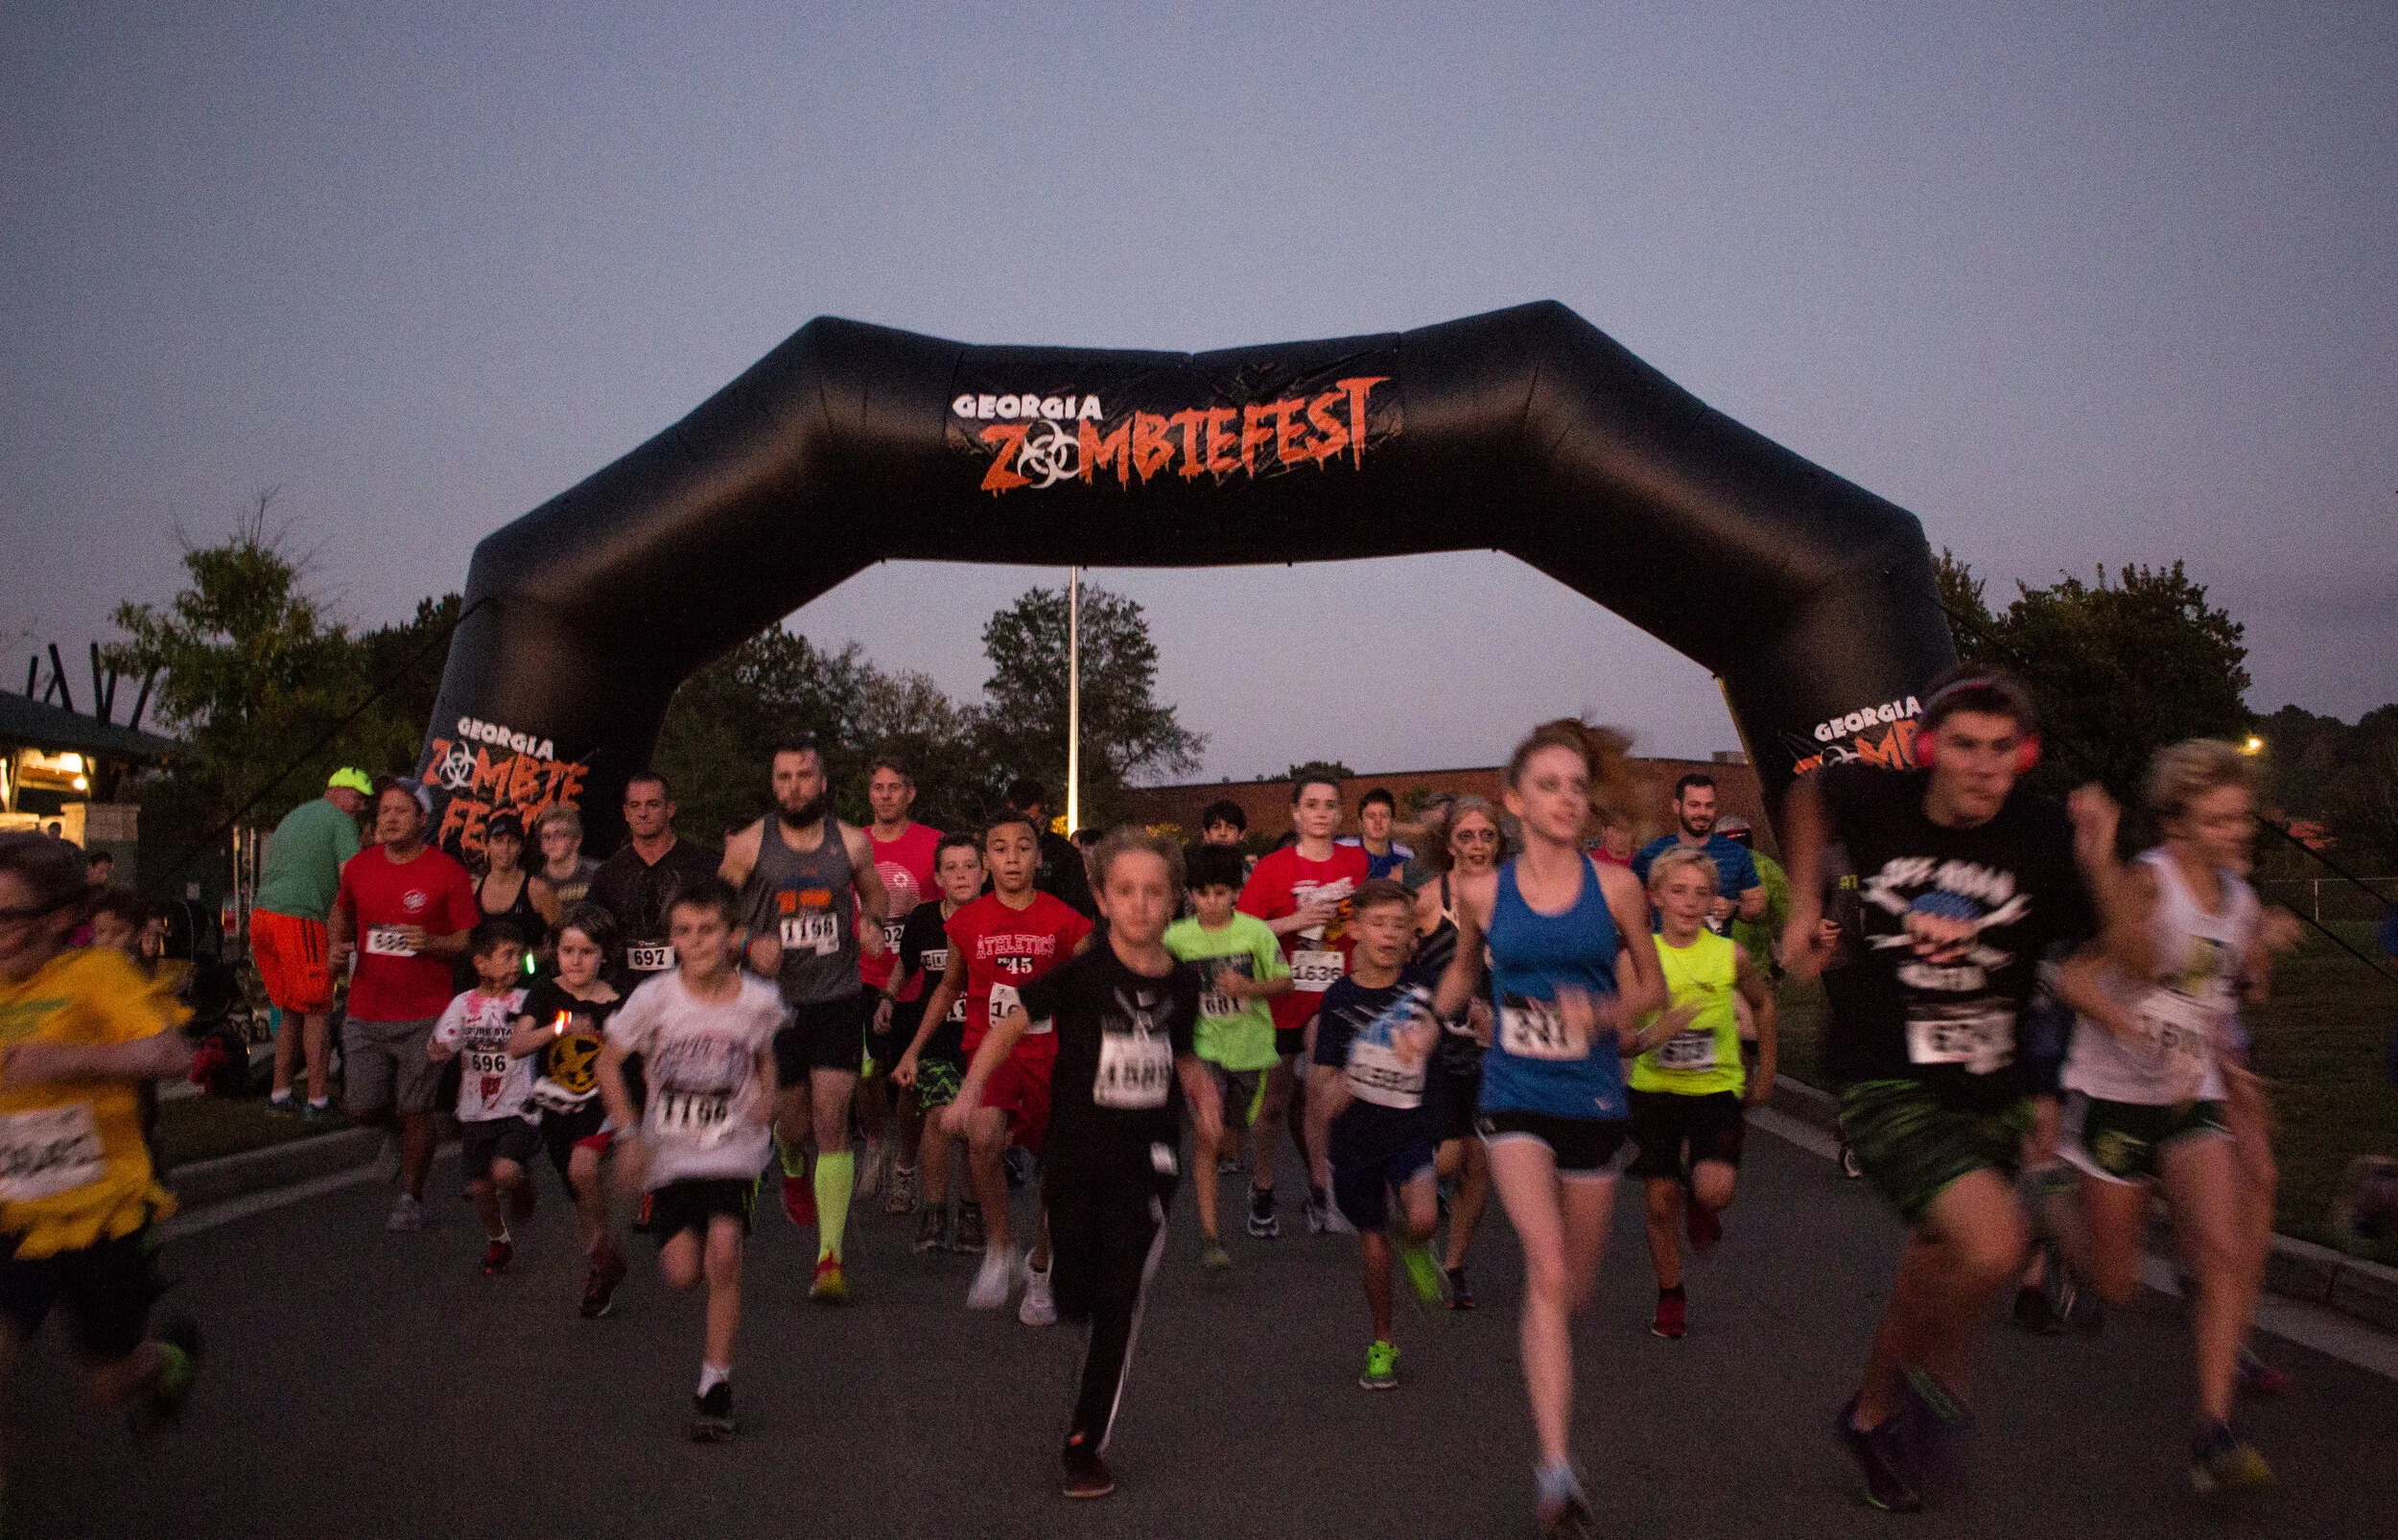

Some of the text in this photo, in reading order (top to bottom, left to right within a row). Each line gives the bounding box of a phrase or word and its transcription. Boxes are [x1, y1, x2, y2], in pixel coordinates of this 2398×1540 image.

[952, 394, 1103, 421] GEORGIA
[979, 376, 1390, 498] ZOMBIEFEST
[1814, 696, 1923, 743] GEORGIA
[457, 716, 554, 761] GEORGIA
[438, 797, 541, 856] FET
[634, 949, 665, 966] 697
[976, 934, 1055, 959] ATHLETICS
[1005, 957, 1033, 974] 45
[473, 1054, 506, 1073] 696
